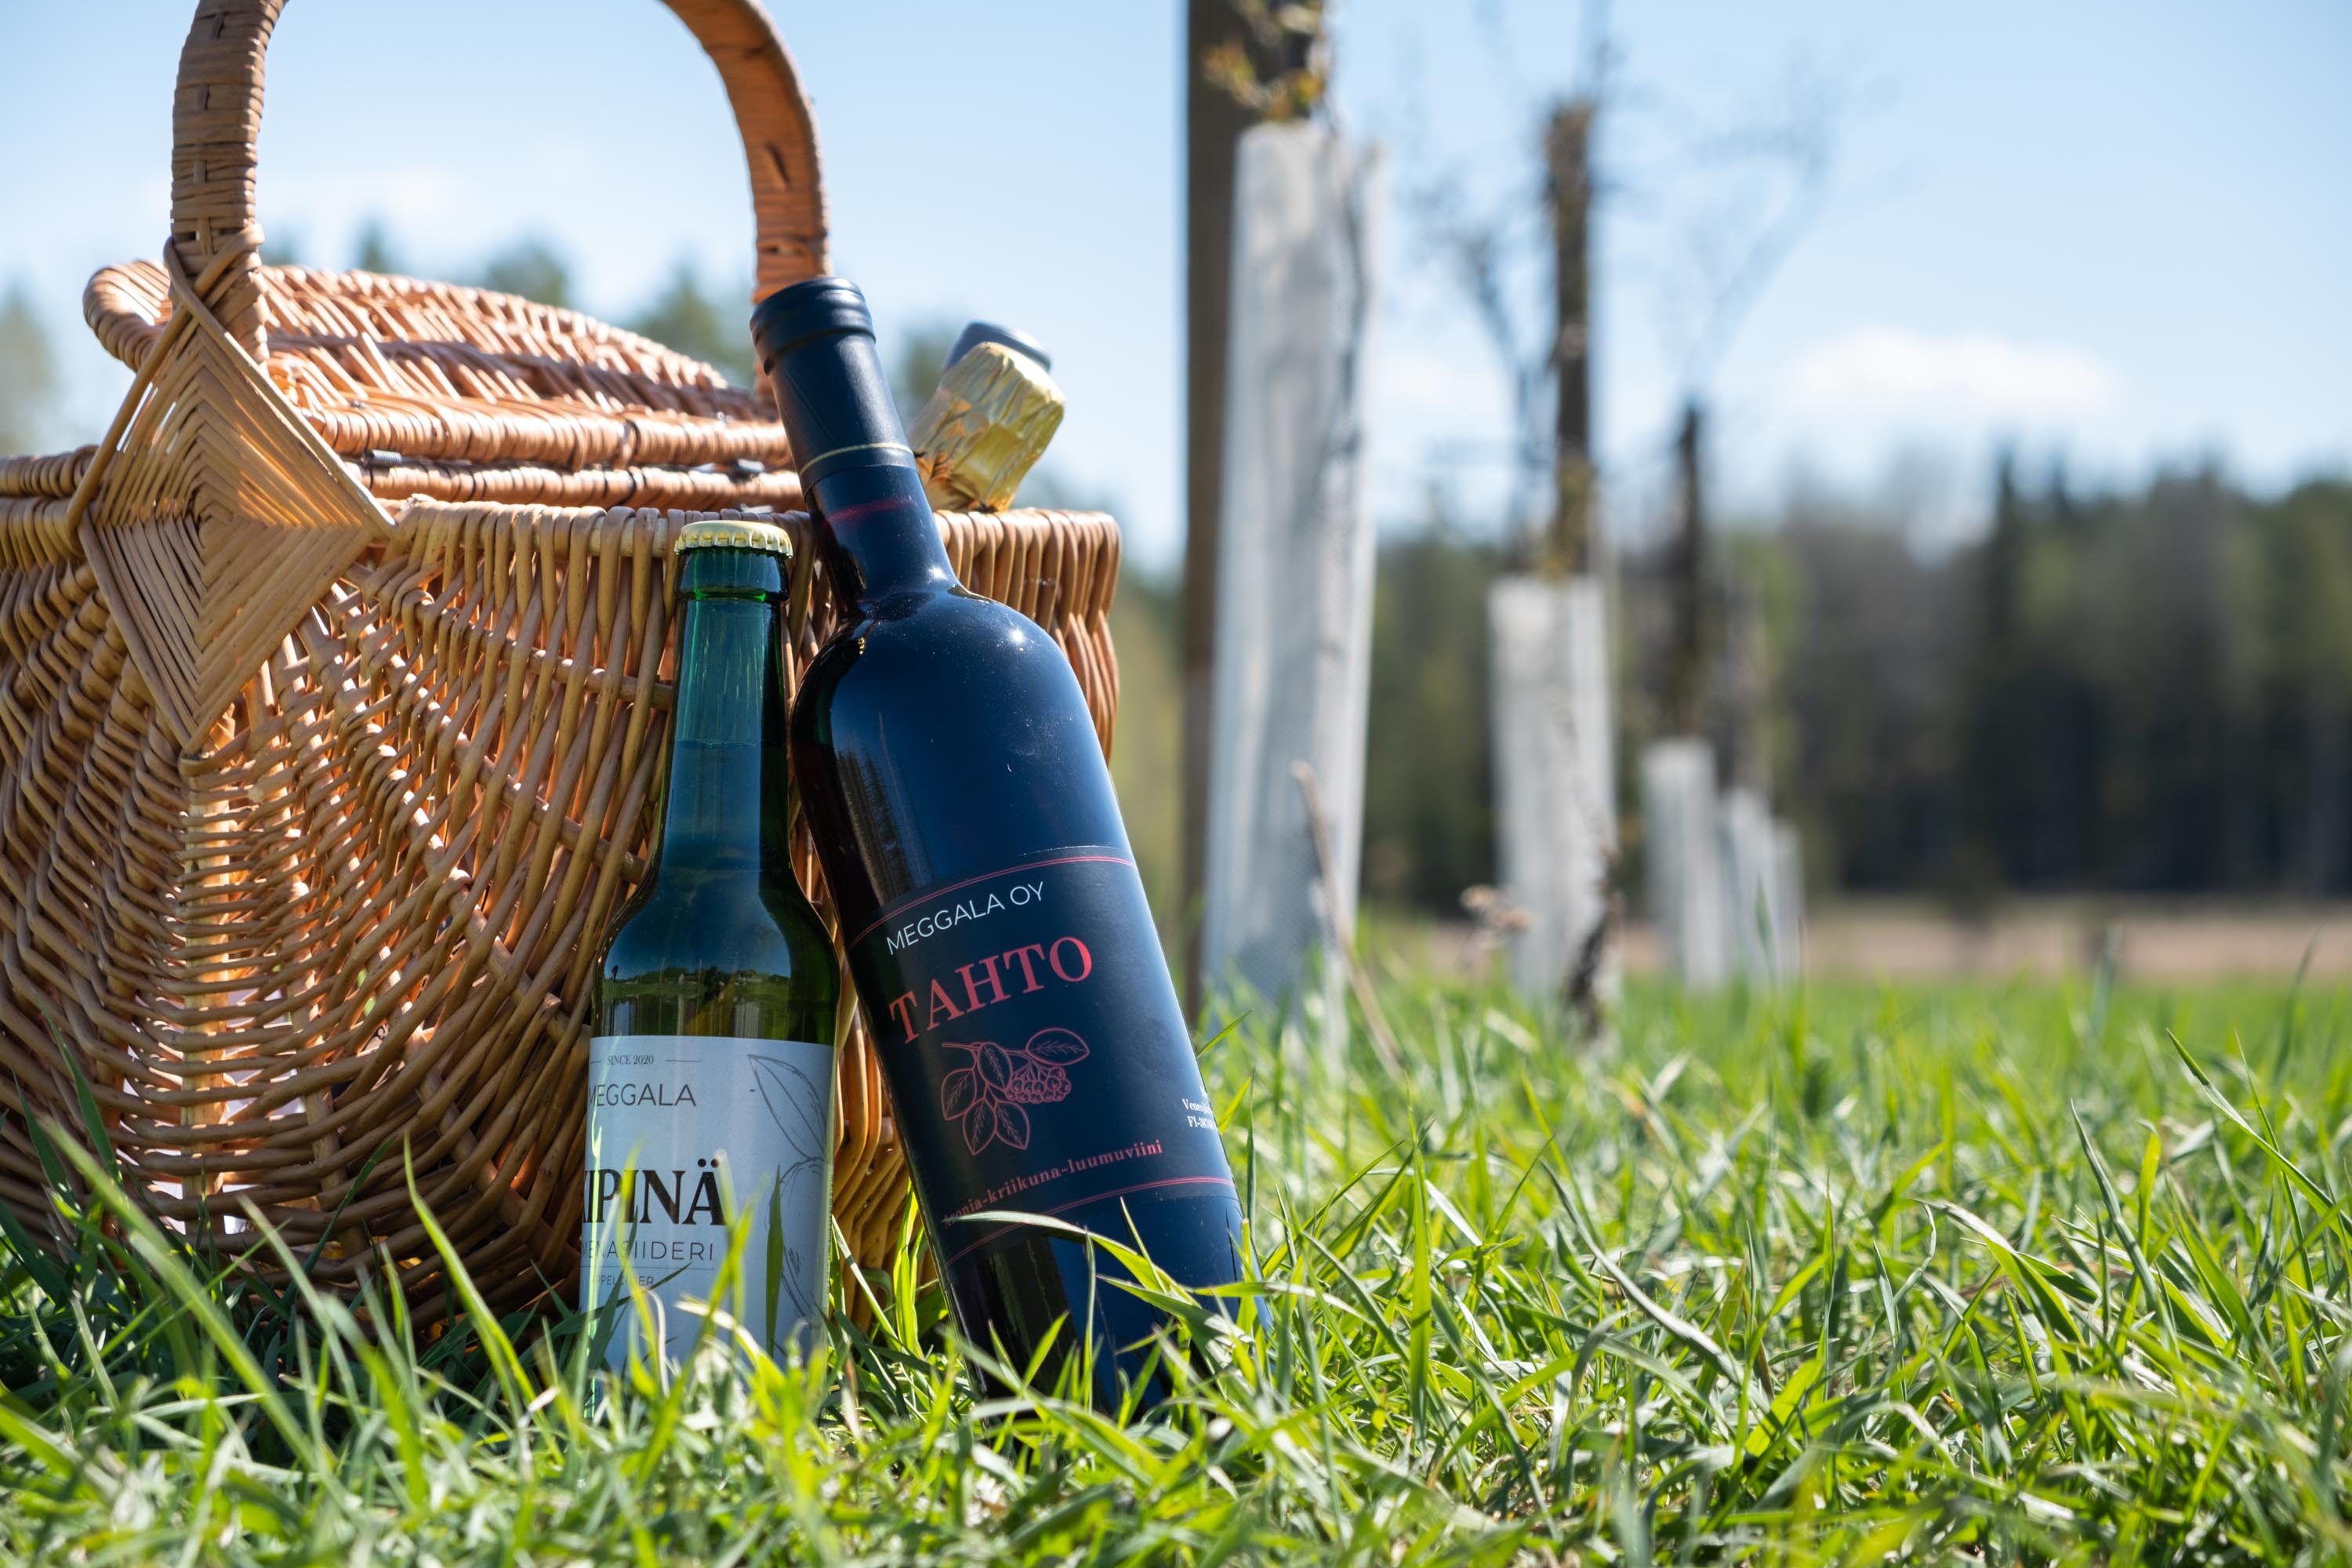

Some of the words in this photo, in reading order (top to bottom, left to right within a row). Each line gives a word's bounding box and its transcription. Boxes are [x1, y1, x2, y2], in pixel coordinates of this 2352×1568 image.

[886, 893, 1006, 956] MEGGALA
[1010, 881, 1045, 906] OY
[888, 936, 1093, 1045] TAHTO
[607, 1054, 632, 1065] SINCE
[633, 1054, 654, 1065] 2020
[589, 1083, 696, 1107] MEGGALA
